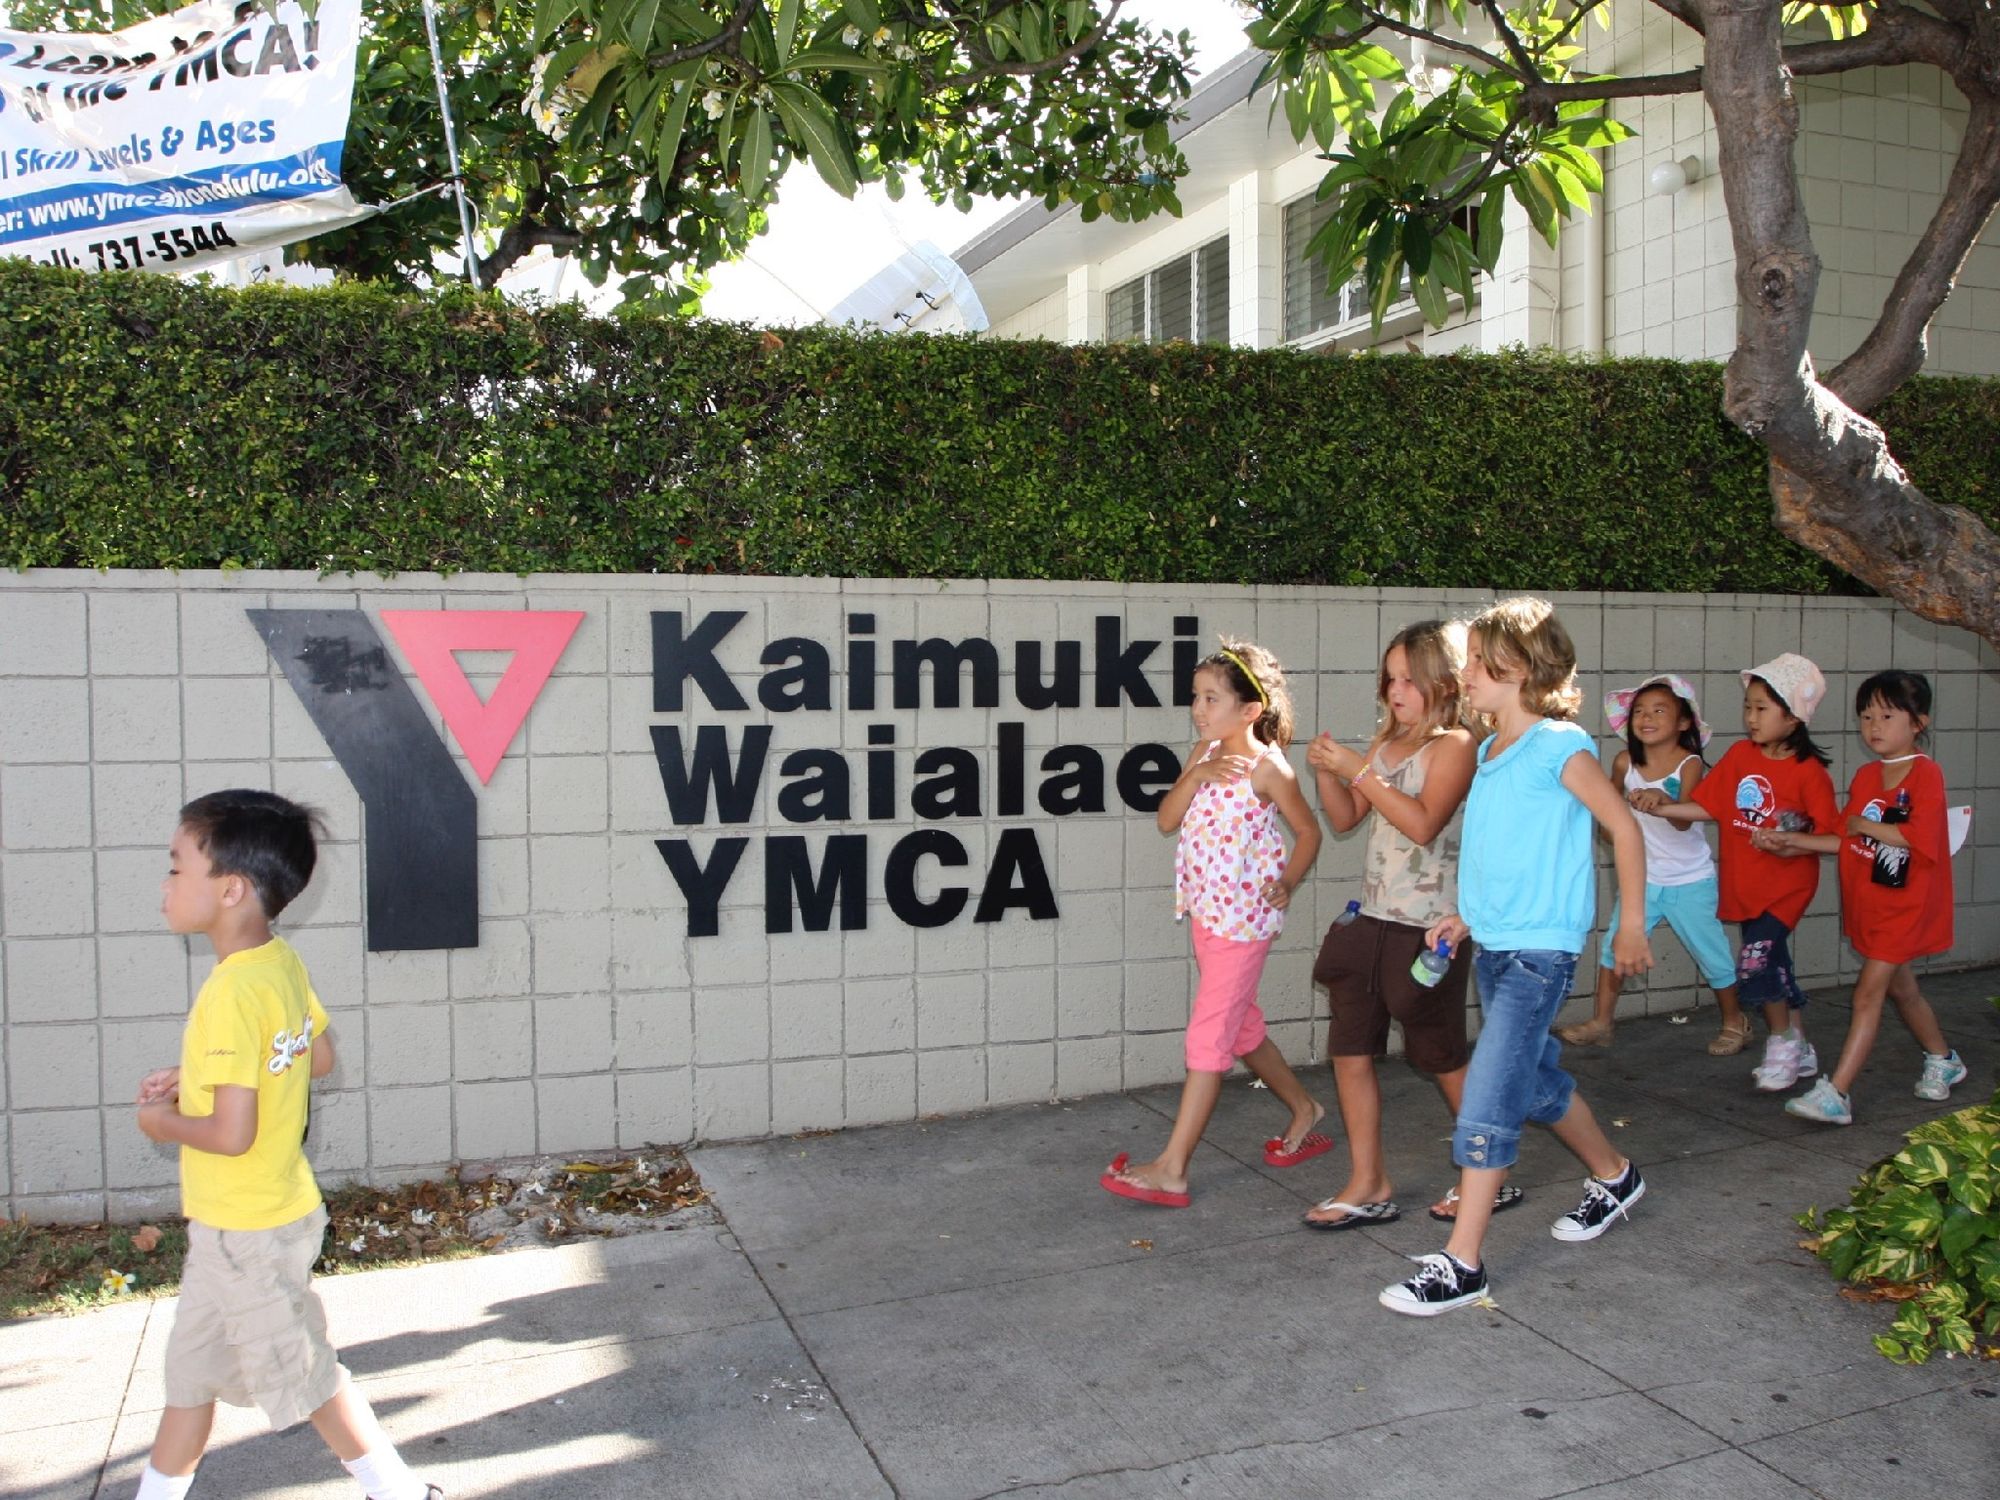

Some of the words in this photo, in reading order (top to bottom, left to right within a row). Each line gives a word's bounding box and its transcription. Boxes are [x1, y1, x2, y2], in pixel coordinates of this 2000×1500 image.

[161, 126, 184, 157] &
[196, 119, 276, 154] Ages
[28, 158, 334, 227] www.ymcahonolulu.org
[89, 221, 237, 272] 737-5544
[650, 611, 1199, 712] Kaimuki
[649, 722, 1183, 825] Waialae
[654, 828, 1059, 938] YMCA
